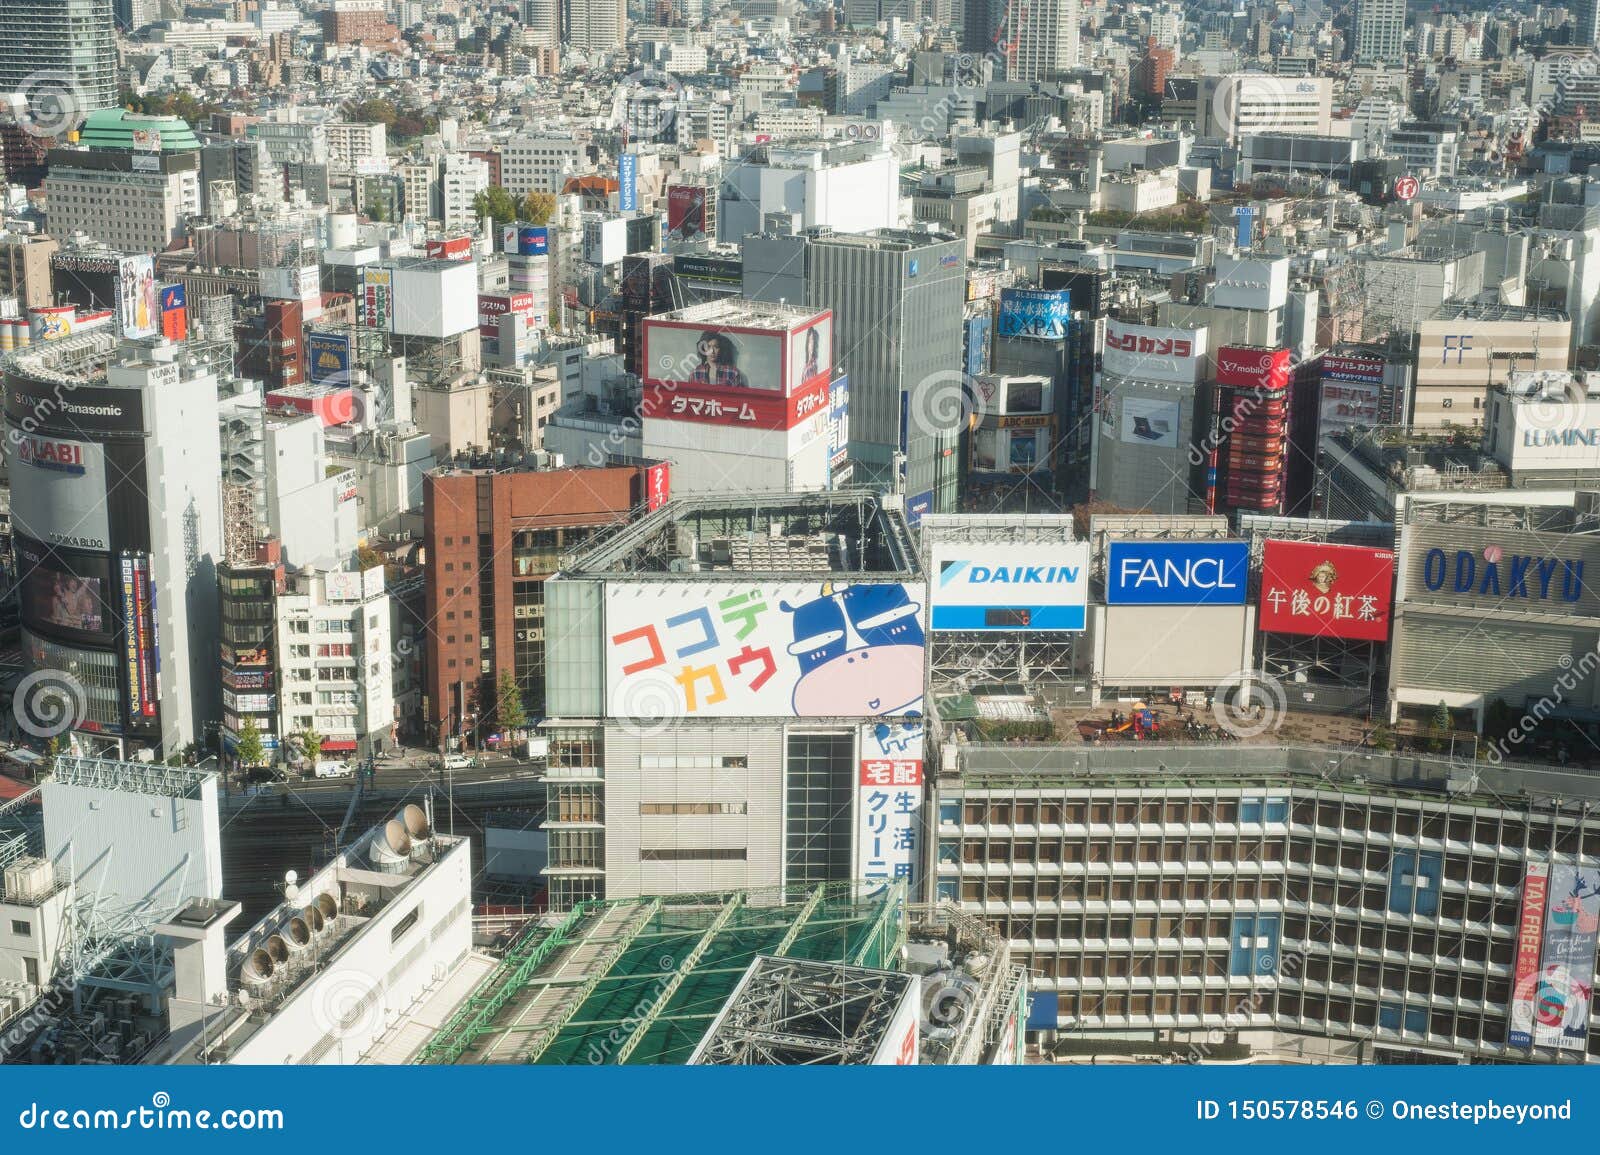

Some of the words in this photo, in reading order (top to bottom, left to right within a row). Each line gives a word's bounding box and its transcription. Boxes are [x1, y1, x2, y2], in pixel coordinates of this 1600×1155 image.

[683, 264, 717, 272] PRESTIA
[1004, 316, 1068, 337] RAPAS
[1106, 328, 1192, 357] ビックカメラ
[1324, 360, 1382, 373] ヨドバシカメラ
[60, 401, 122, 416] Panasonic
[671, 395, 757, 421] タマホーム
[796, 388, 825, 419] タマホーム
[31, 438, 81, 465] LABI
[968, 566, 1080, 583] DAIKIN
[1120, 558, 1236, 588] FANCL
[1424, 547, 1585, 602] ODAKYU
[1267, 587, 1377, 622] 午後の紅茶
[867, 761, 917, 784] 宅配
[1525, 880, 1545, 911] TAX
[1521, 914, 1540, 954] FREE
